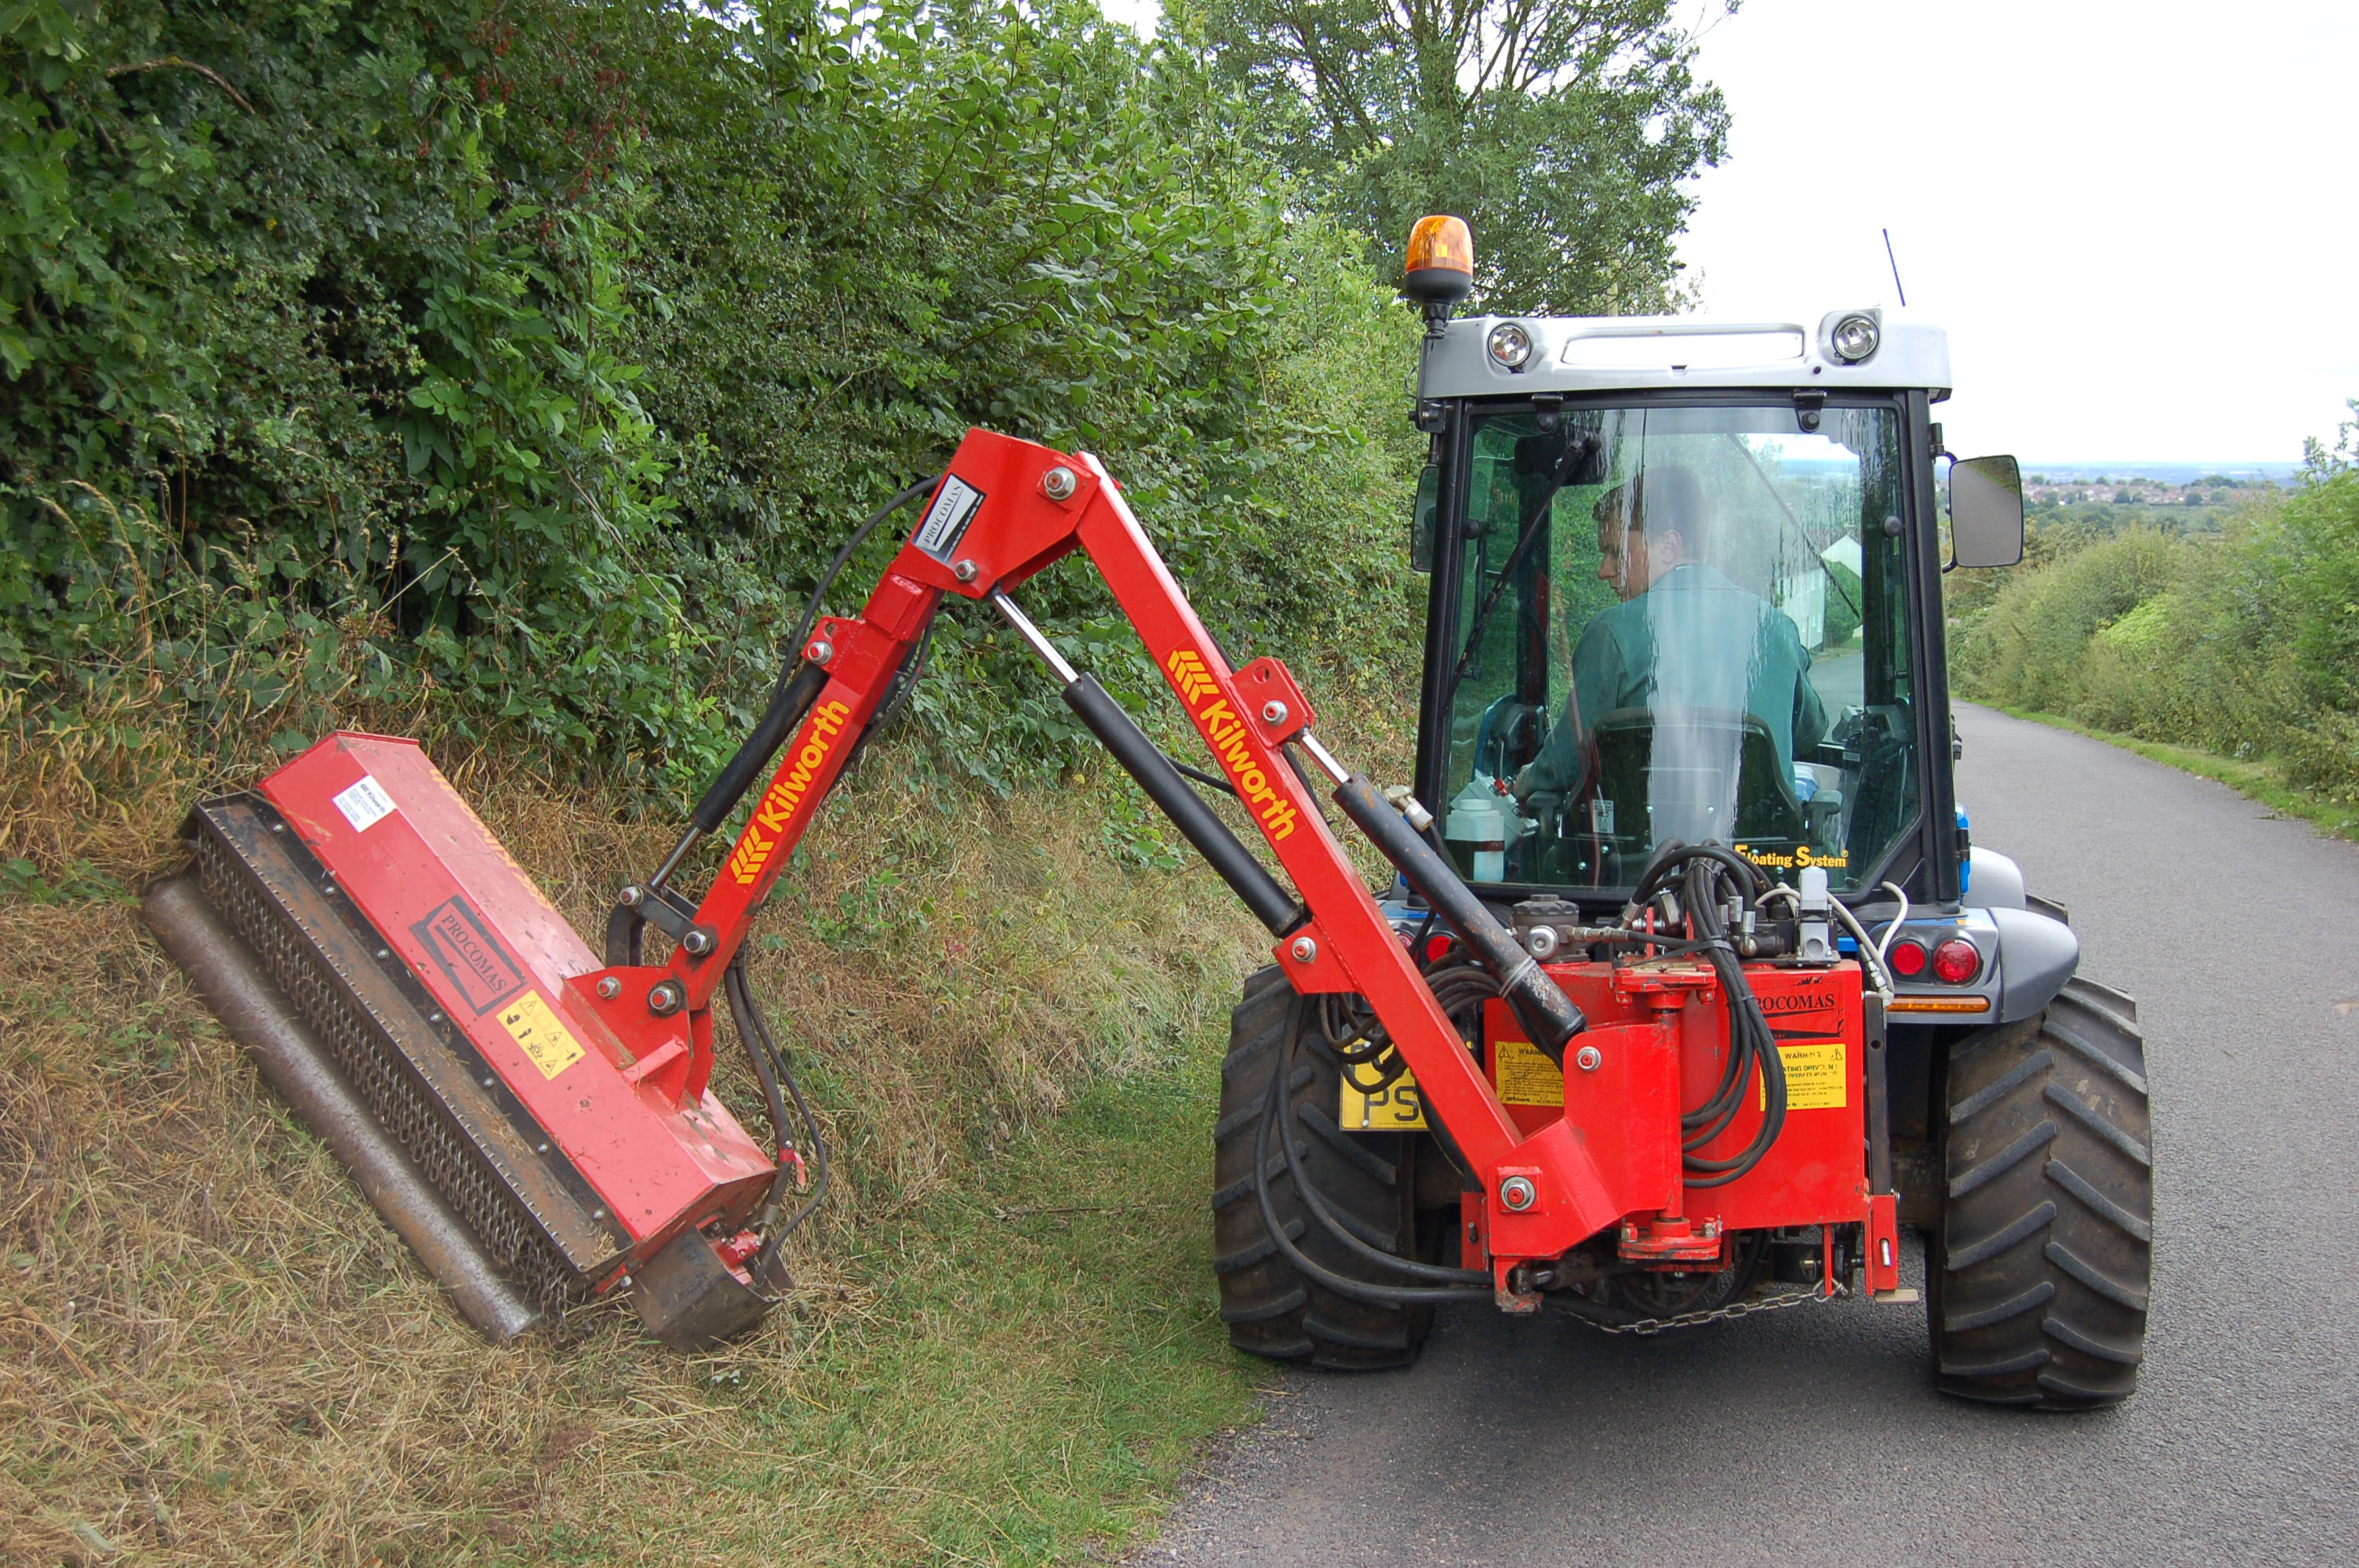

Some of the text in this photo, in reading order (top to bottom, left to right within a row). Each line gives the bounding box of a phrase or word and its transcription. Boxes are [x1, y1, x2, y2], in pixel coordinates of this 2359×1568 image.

[924, 486, 961, 543] PROCOMAS
[757, 701, 849, 833] Kilworth
[1200, 699, 1296, 840] Kilworth
[442, 914, 507, 992] PROCOMAS
[1756, 993, 1835, 1011] ROCOMAS
